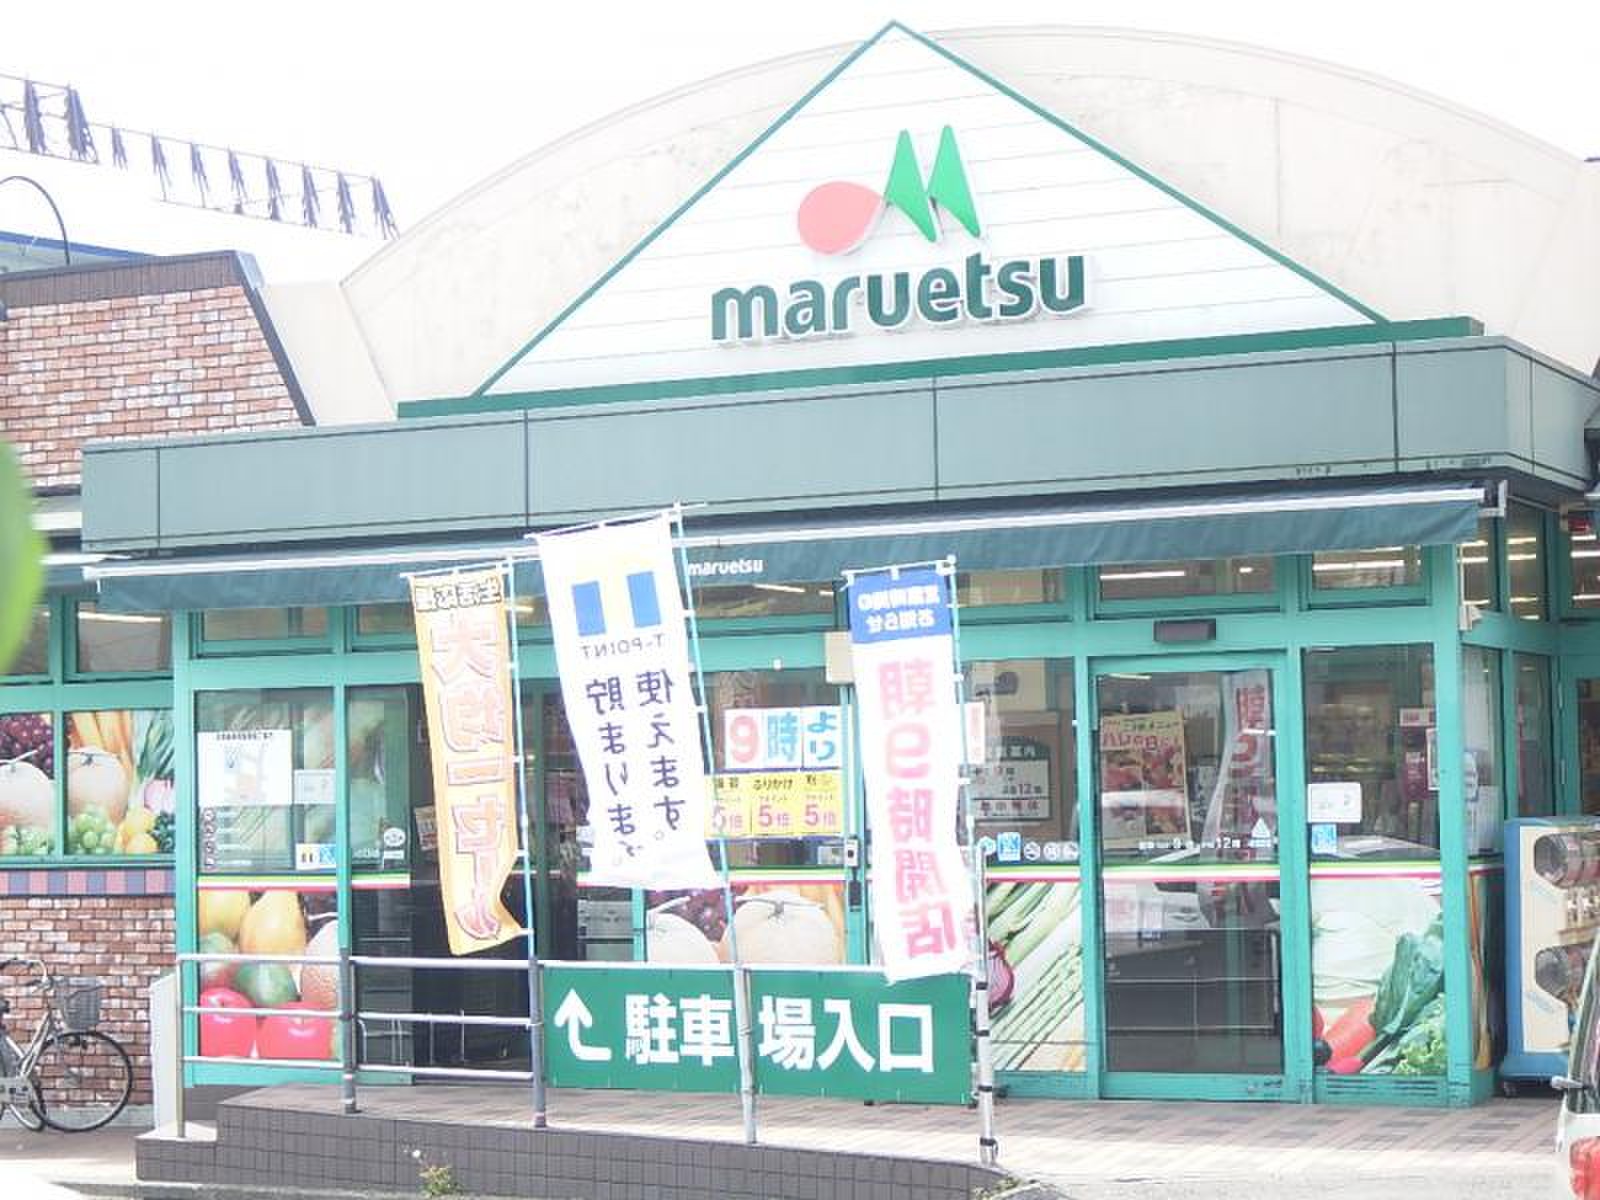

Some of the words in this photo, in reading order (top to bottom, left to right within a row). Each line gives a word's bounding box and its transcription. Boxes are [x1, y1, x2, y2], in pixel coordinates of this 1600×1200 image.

[711, 252, 1085, 341] maruetsu
[687, 559, 763, 577] maruetsu
[625, 993, 935, 1073] 駐車場入口
